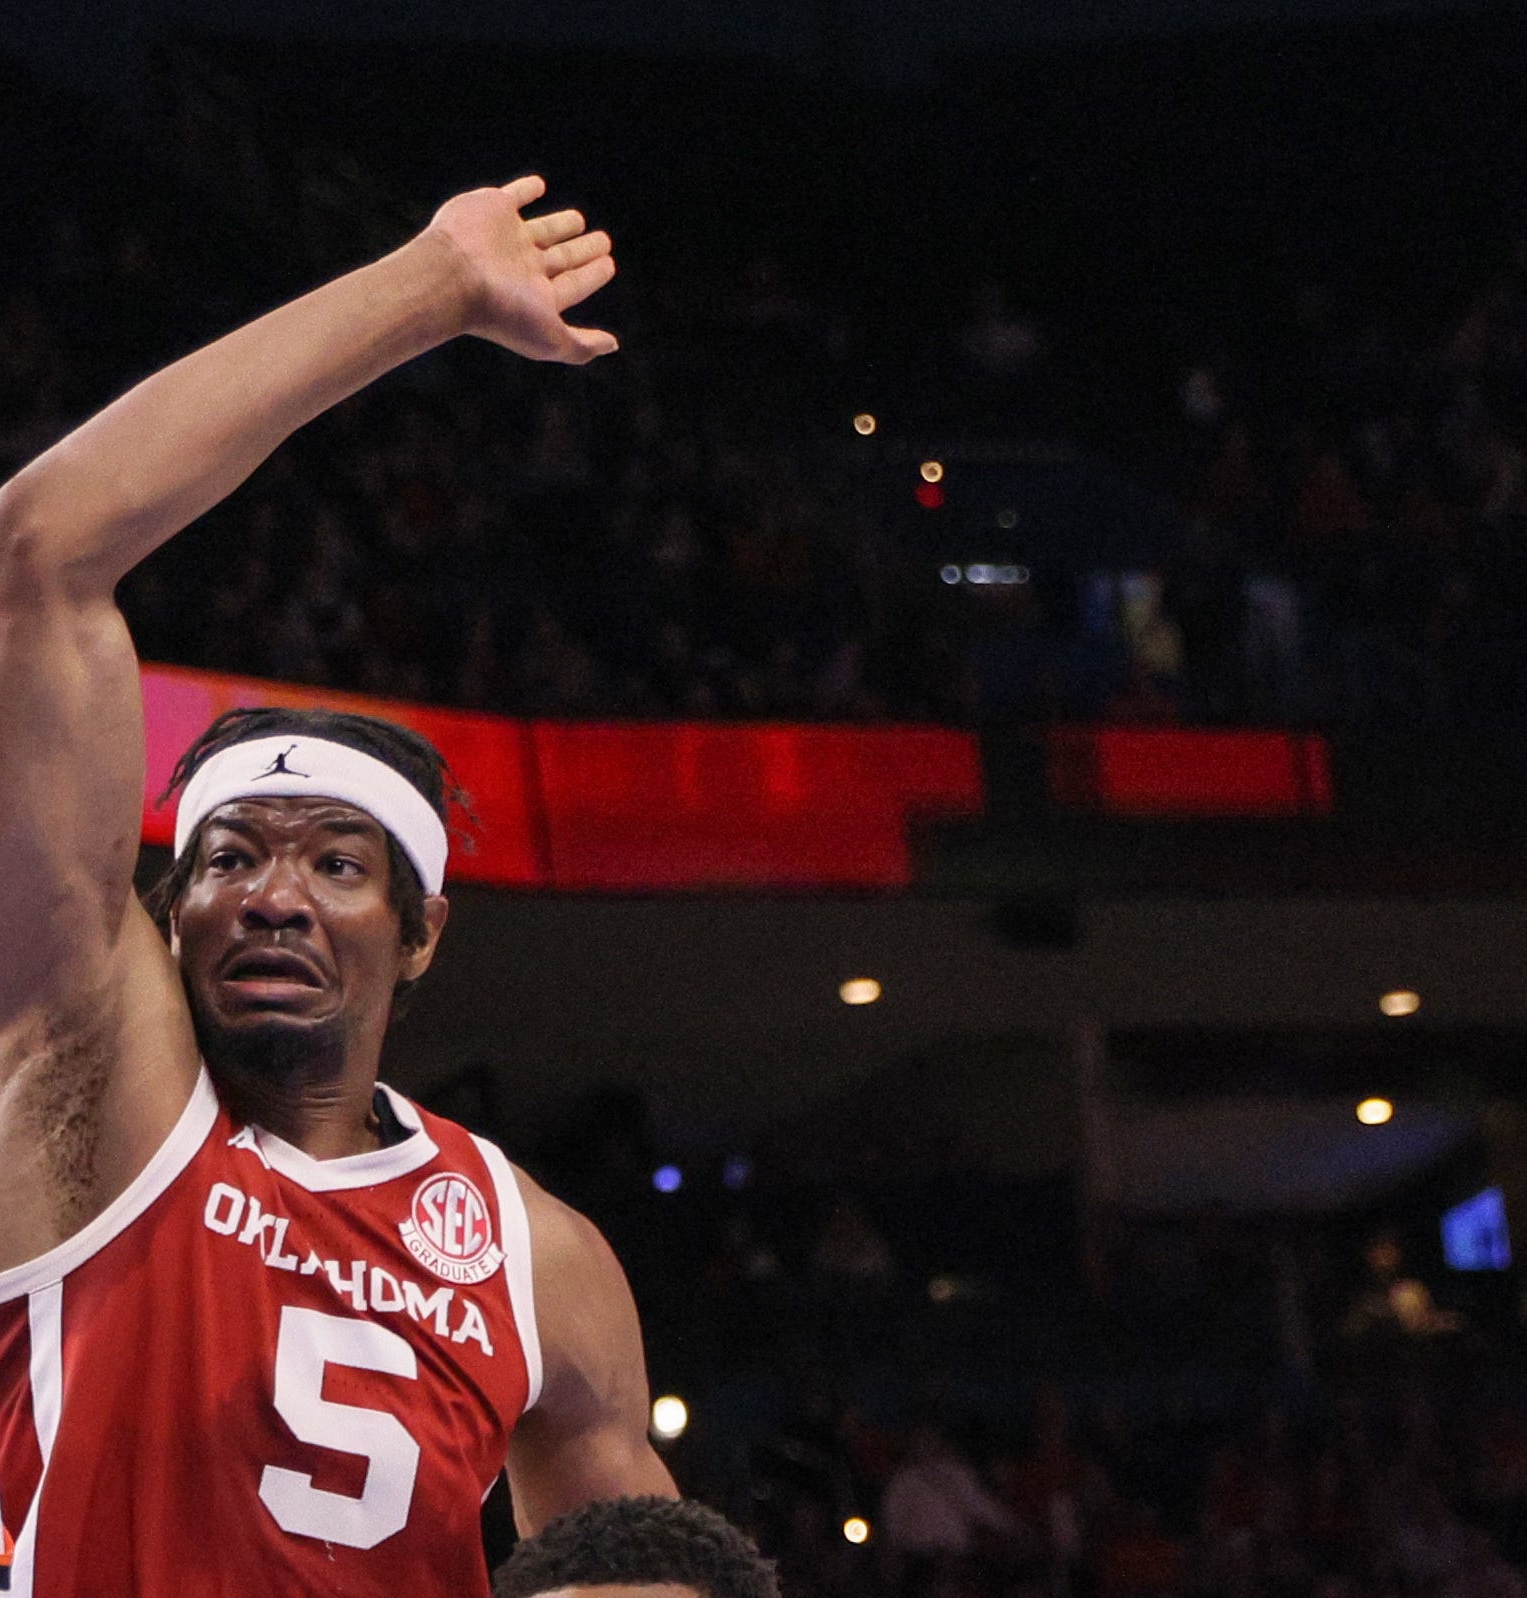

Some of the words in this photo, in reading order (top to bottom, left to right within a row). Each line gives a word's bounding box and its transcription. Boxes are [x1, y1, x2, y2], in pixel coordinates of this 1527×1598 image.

[419, 1178, 485, 1257] SEC
[409, 1238, 492, 1281] GRADUATE
[257, 1304, 421, 1550] 5
